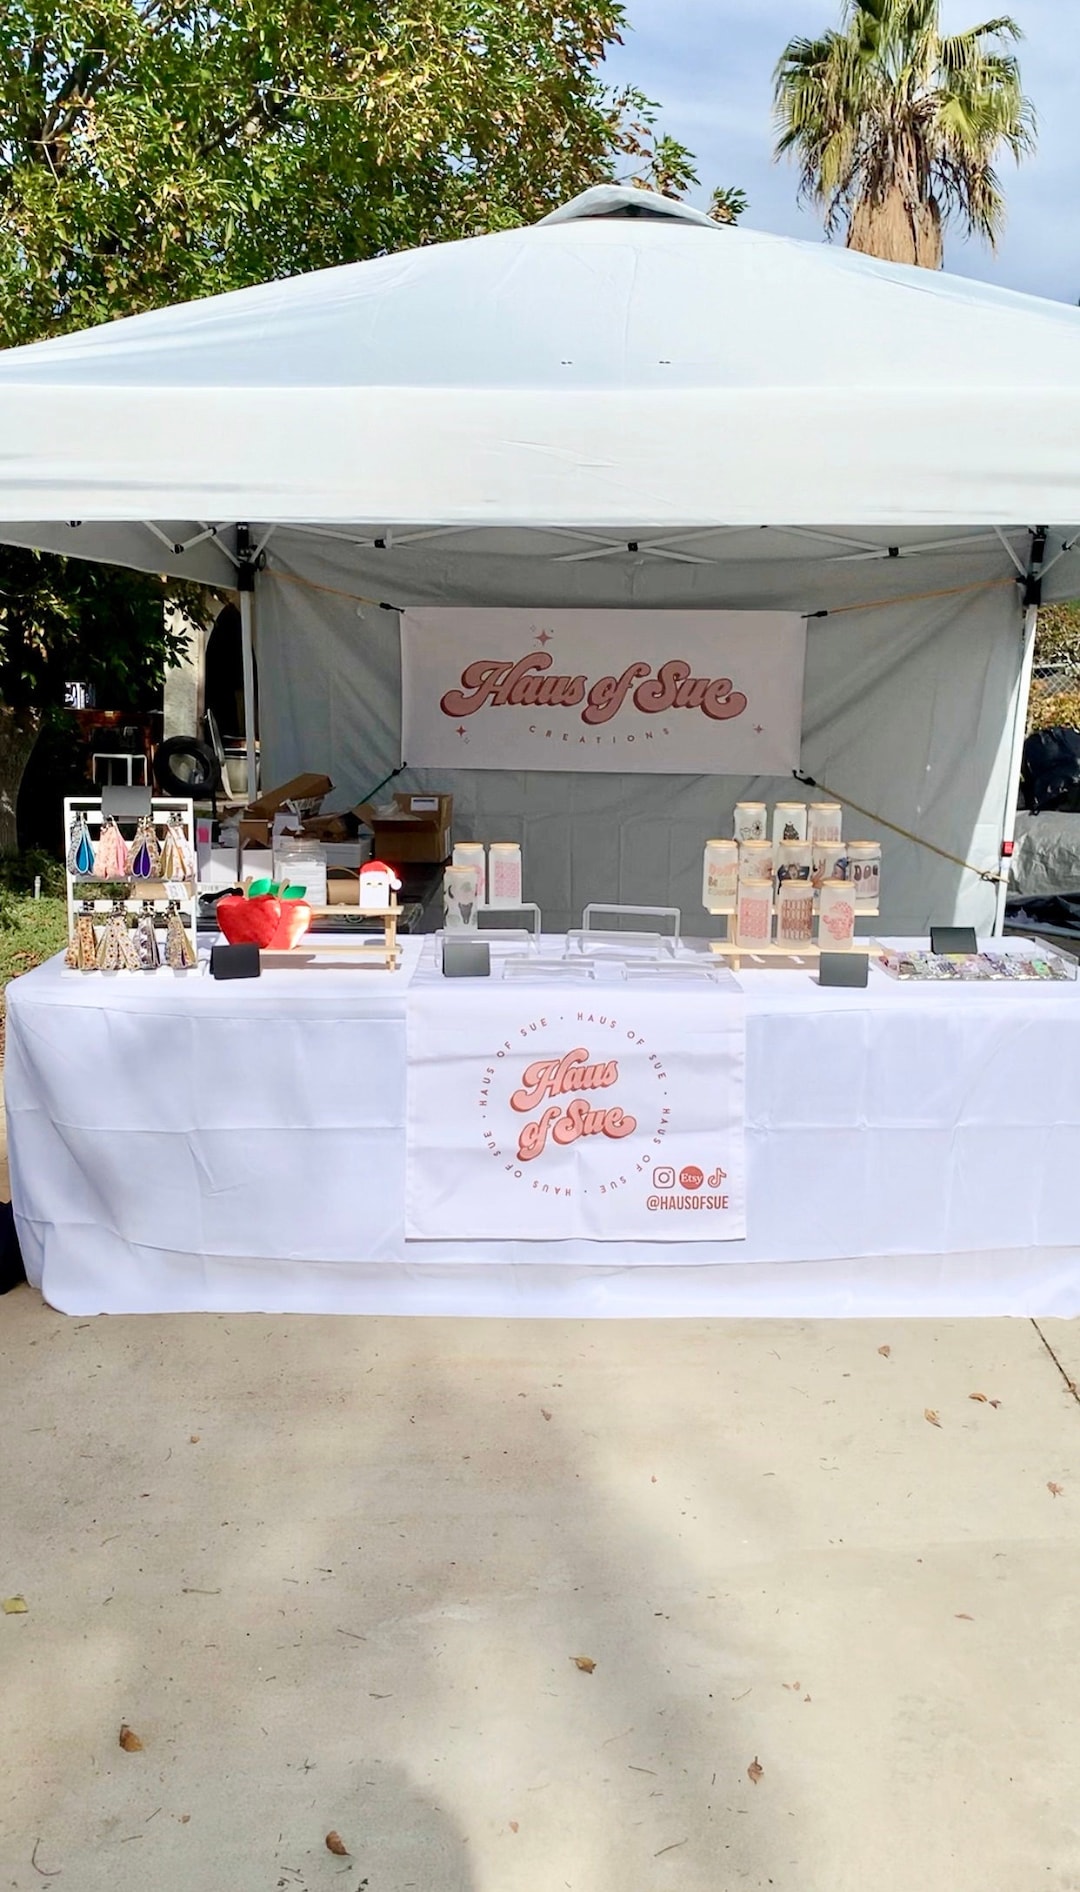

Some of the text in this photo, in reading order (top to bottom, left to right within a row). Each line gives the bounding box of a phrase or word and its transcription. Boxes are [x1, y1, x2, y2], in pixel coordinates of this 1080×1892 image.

[440, 651, 748, 725] Haus of Sue
[529, 725, 671, 744] CREATIONS
[479, 1018, 548, 1107] HAUS OF SUE
[577, 1011, 667, 1080] HAUS OF SUE
[510, 1047, 618, 1112] Haus
[516, 1098, 637, 1161] of Sue
[600, 1107, 671, 1194] HAUS OF SUE
[483, 1131, 572, 1197] HAUS OF SUE
[680, 1172, 703, 1185] Etsy
[646, 1195, 729, 1211] @HAUSOFSUE
